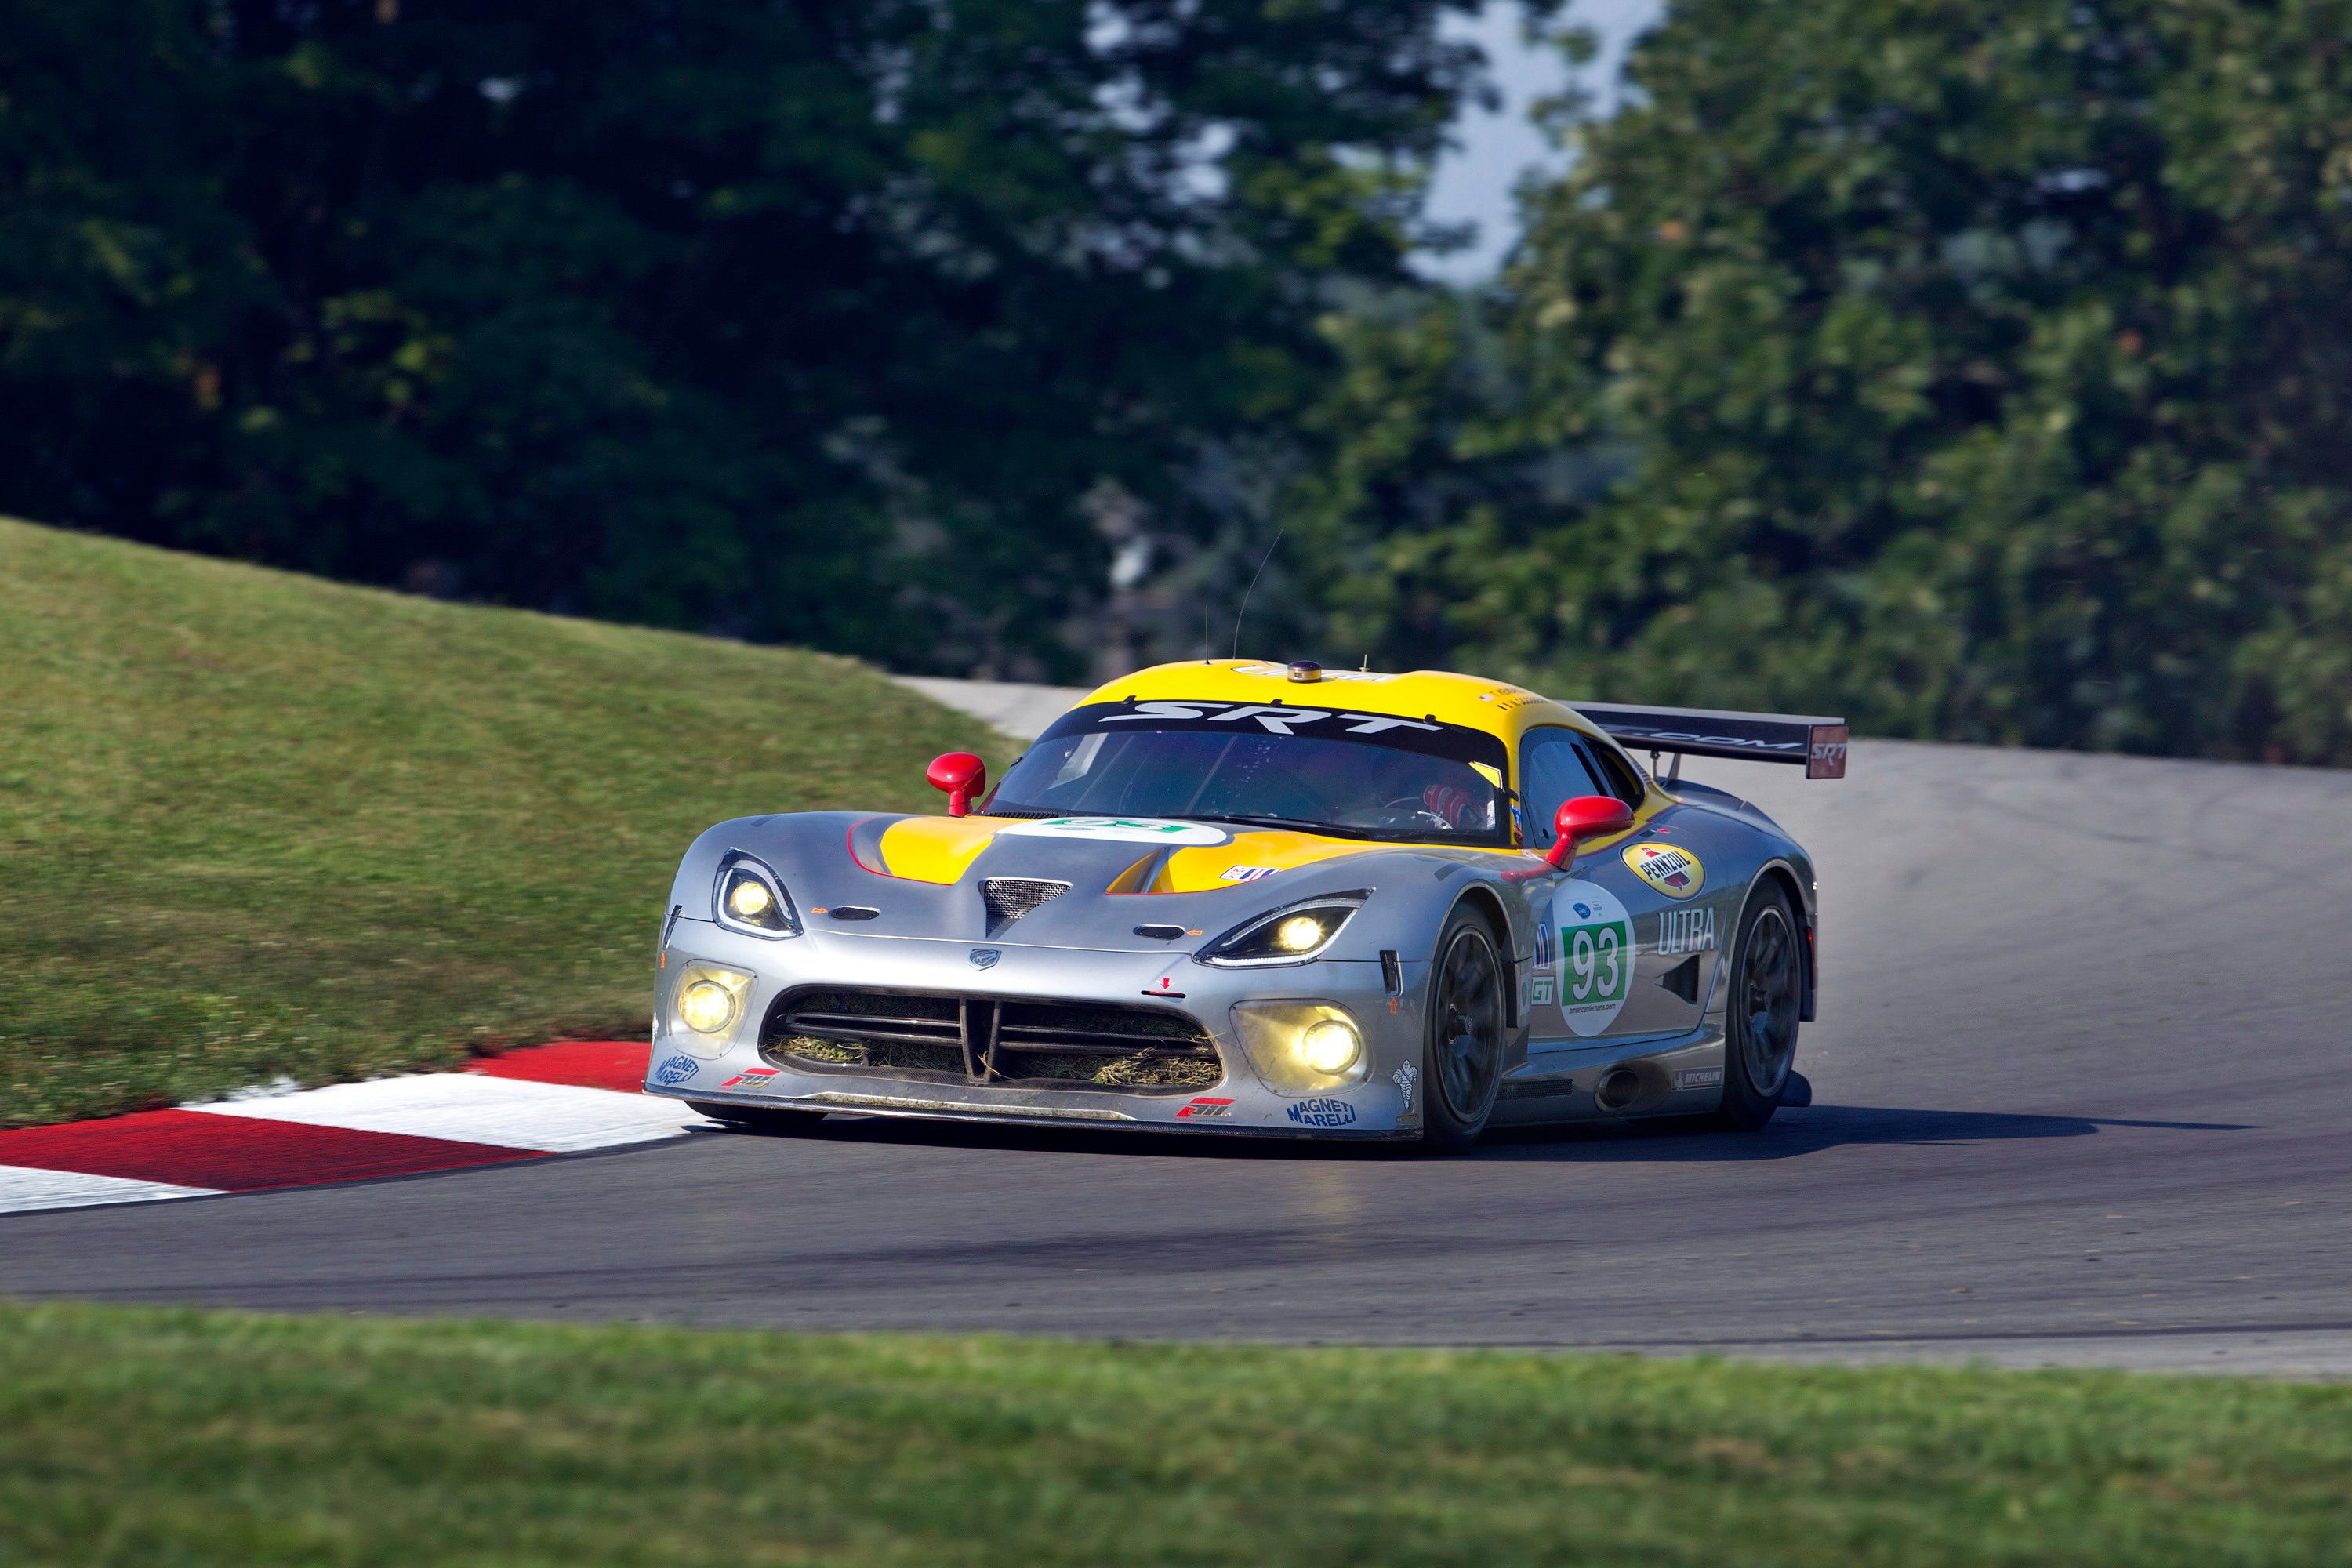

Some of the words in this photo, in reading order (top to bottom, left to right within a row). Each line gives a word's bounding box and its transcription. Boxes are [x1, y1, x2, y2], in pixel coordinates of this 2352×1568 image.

[1098, 702, 1443, 735] SRT
[1811, 742, 1847, 766] SRT
[1639, 851, 1691, 881] PENNZOIL
[1657, 907, 1715, 956] ULTRA
[1572, 927, 1620, 1000] 93
[1533, 980, 1553, 1001] GT
[1685, 1072, 1722, 1083] MICHELIN
[1287, 1098, 1357, 1114] MAGNETI
[1287, 1112, 1357, 1127] MARELLI
